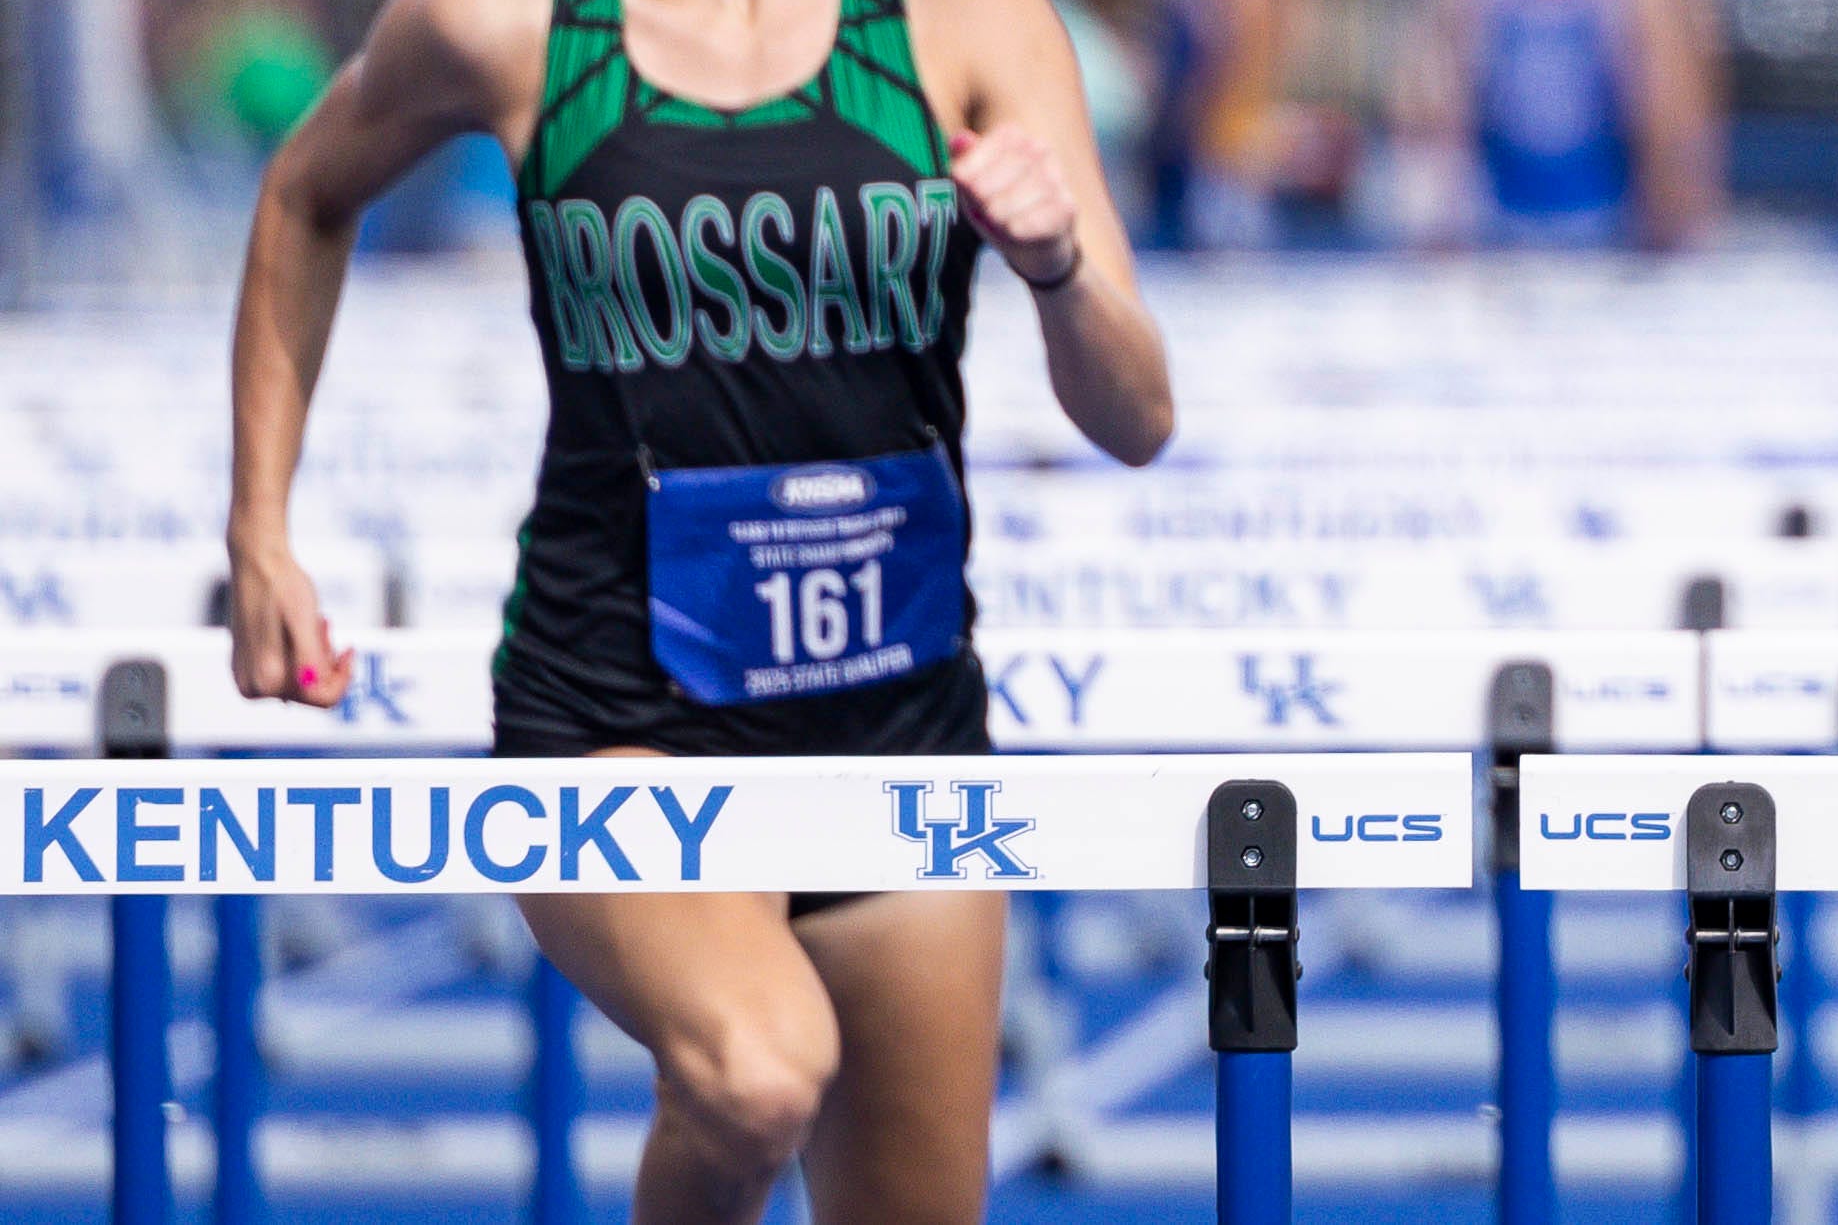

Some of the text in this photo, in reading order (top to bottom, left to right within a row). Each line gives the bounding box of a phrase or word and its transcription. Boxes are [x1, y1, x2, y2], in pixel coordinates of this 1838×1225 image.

[528, 178, 957, 371] BROSSART
[754, 558, 883, 665] 161
[23, 785, 734, 883] KENTUCKY
[884, 781, 1037, 880] UK
[1312, 814, 1443, 842] UCS
[1540, 813, 1672, 841] UCS
